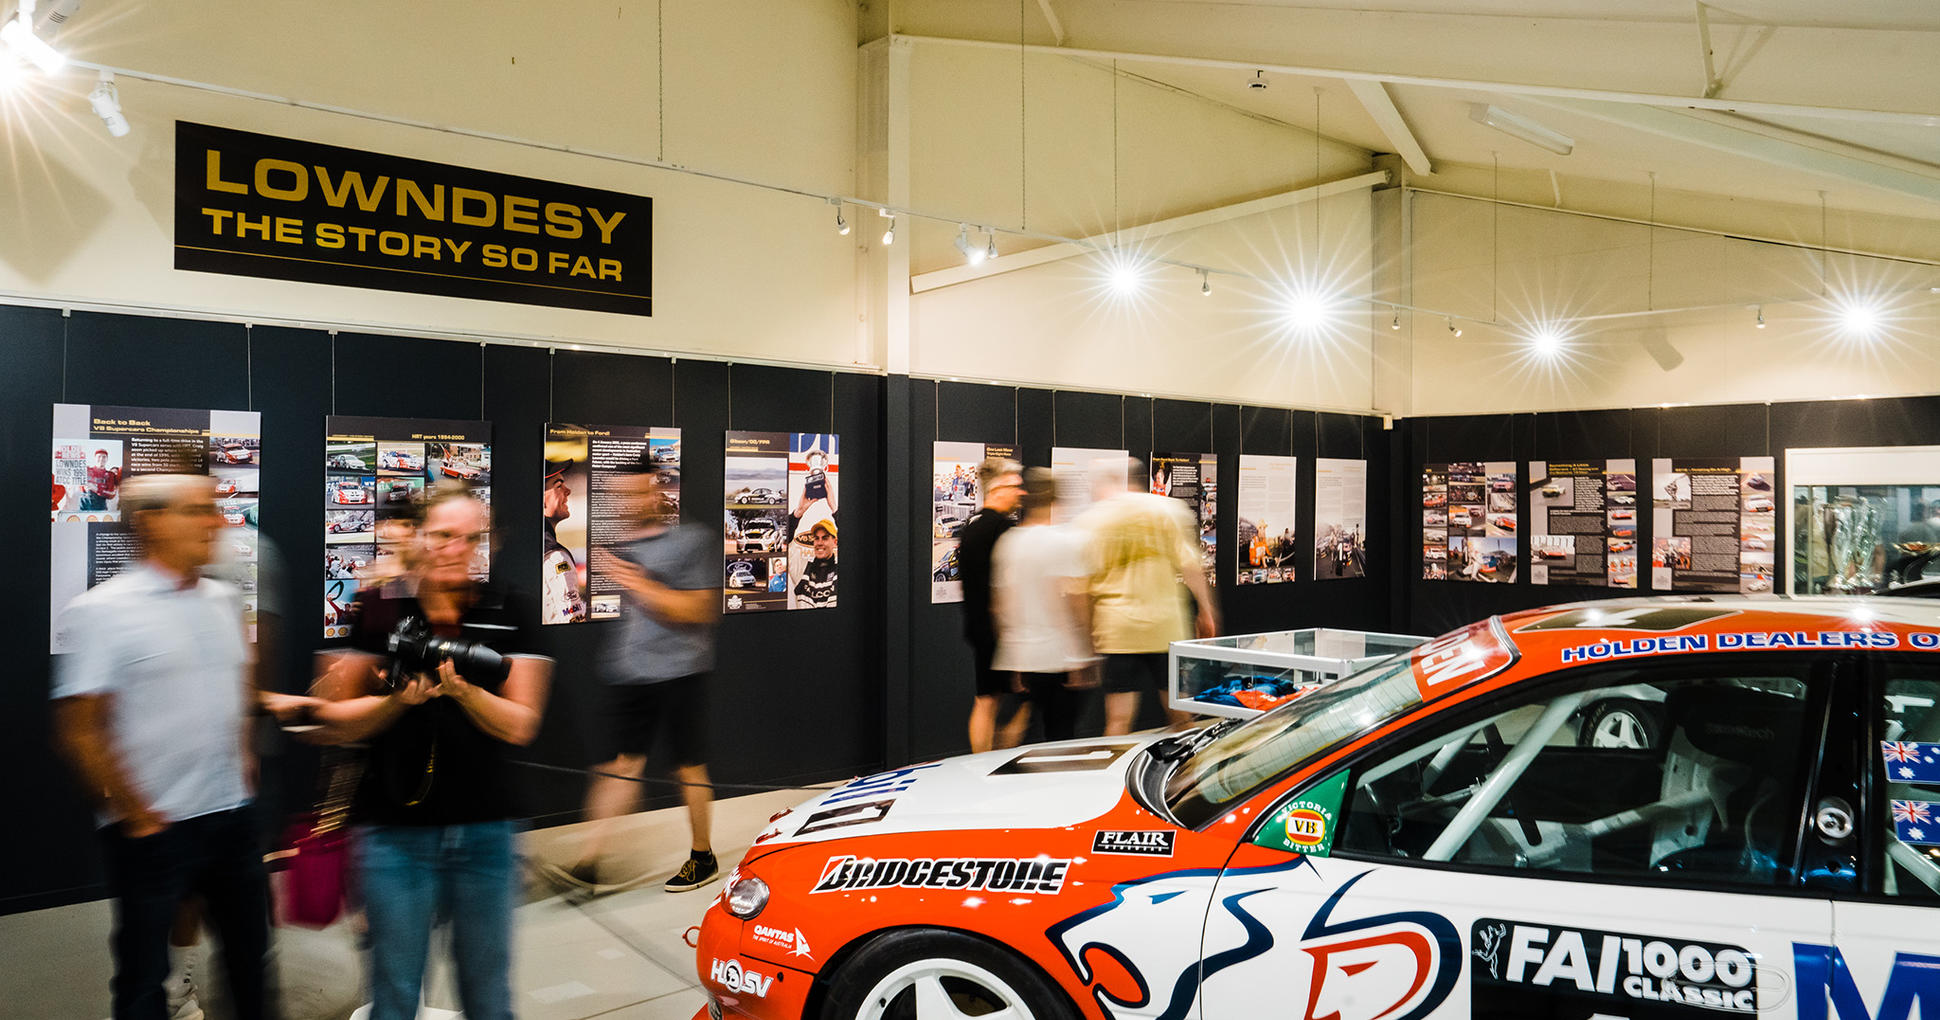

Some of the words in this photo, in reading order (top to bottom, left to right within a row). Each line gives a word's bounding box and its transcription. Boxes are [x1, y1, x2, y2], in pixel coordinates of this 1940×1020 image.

[206, 149, 627, 244] LOWNDESY
[201, 207, 303, 244] THE
[315, 222, 472, 263] STORY
[482, 244, 538, 272] SO
[548, 252, 622, 282] FAR
[146, 427, 199, 435] Championships
[1562, 633, 1706, 664] HOLDEN
[1716, 631, 1900, 650] DEALERS
[1281, 801, 1332, 820] VICTORIA
[1101, 832, 1168, 846] FLAIR
[1294, 820, 1318, 834] VB
[1283, 838, 1324, 853] BITTER
[812, 855, 1070, 894] BRIDGESTONE
[754, 924, 794, 943] QANTAS
[1506, 924, 1622, 994] FAI
[1622, 938, 1753, 988] 1000
[1622, 975, 1755, 1012] CLASSIC
